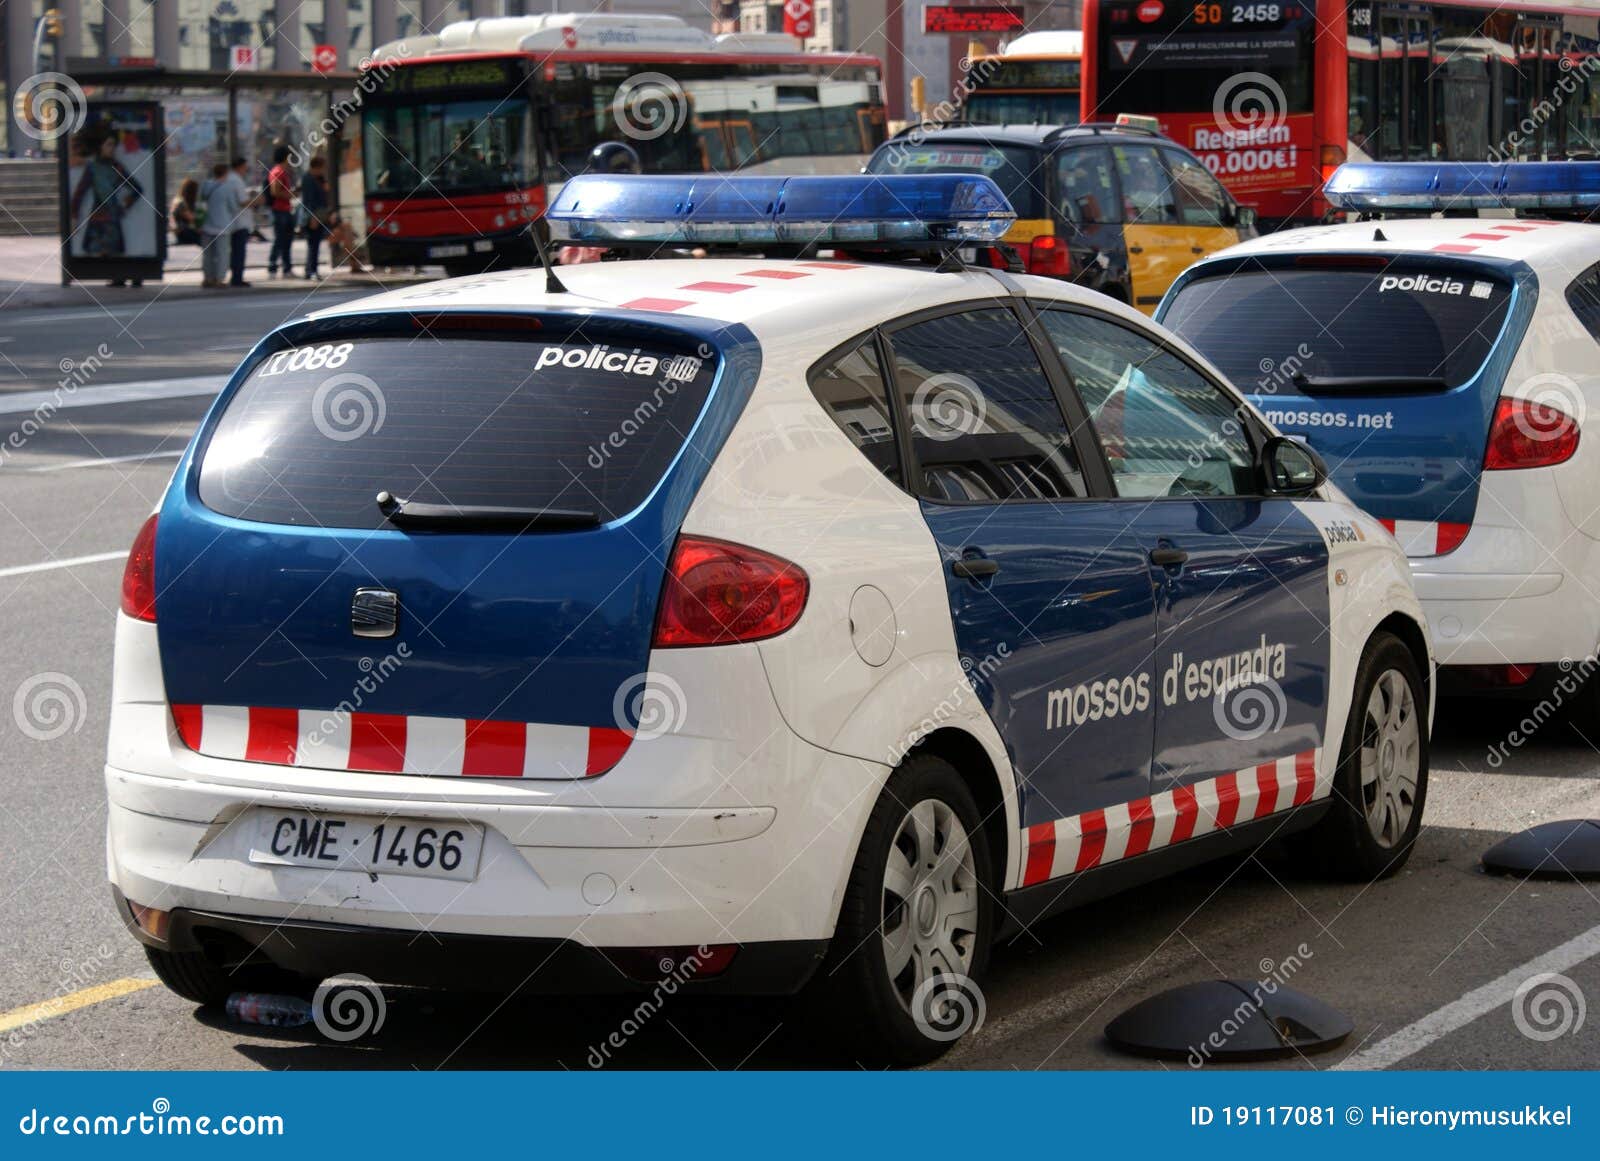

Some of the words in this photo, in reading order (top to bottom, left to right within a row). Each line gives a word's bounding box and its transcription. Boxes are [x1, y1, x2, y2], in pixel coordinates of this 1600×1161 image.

[1231, 5, 1280, 22] 2458
[1352, 9, 1371, 26] 2458
[1194, 124, 1290, 153] Regalem
[1379, 274, 1464, 295] policia
[534, 344, 659, 376] policia
[1265, 409, 1394, 429] mossos.net
[1046, 672, 1150, 730] mossos
[1162, 634, 1286, 706] d'esquadra
